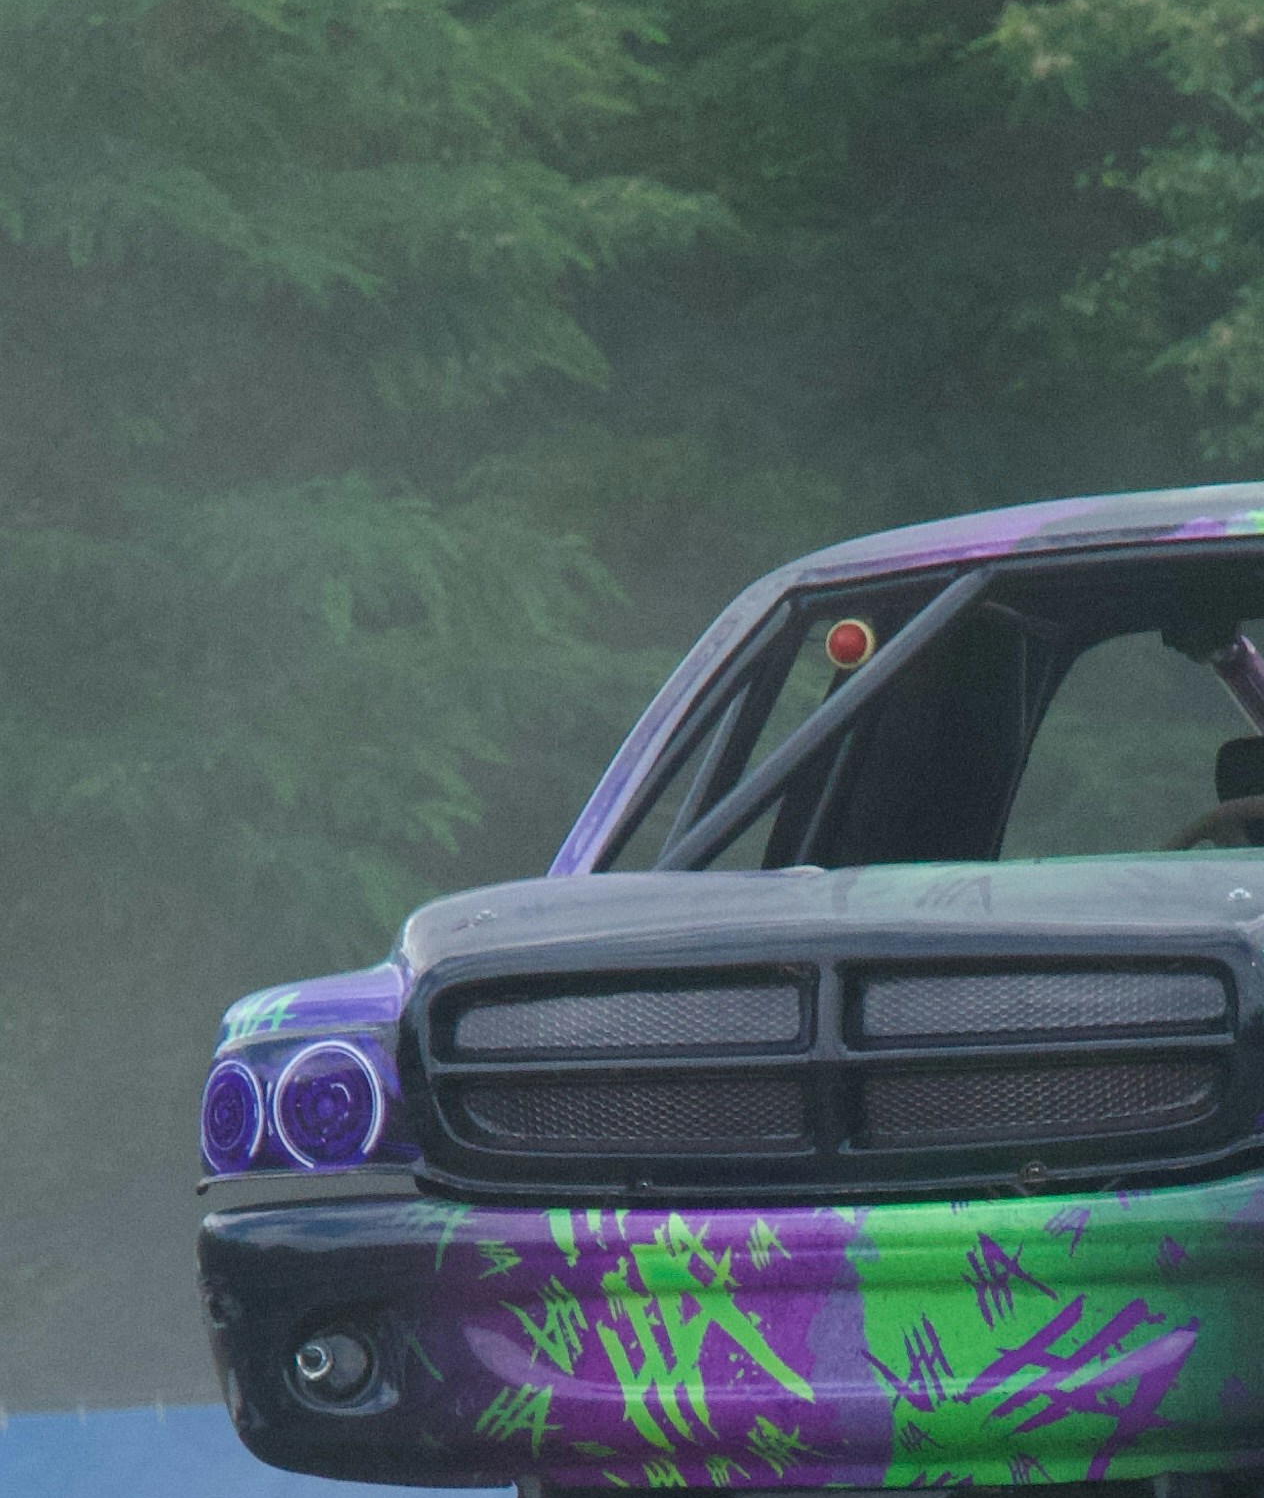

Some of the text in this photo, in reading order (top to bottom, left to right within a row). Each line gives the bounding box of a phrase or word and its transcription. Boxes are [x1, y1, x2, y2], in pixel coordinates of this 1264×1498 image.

[961, 1232, 1058, 1331] HA
[474, 1383, 563, 1458] HA
[952, 1293, 1200, 1482] HA
